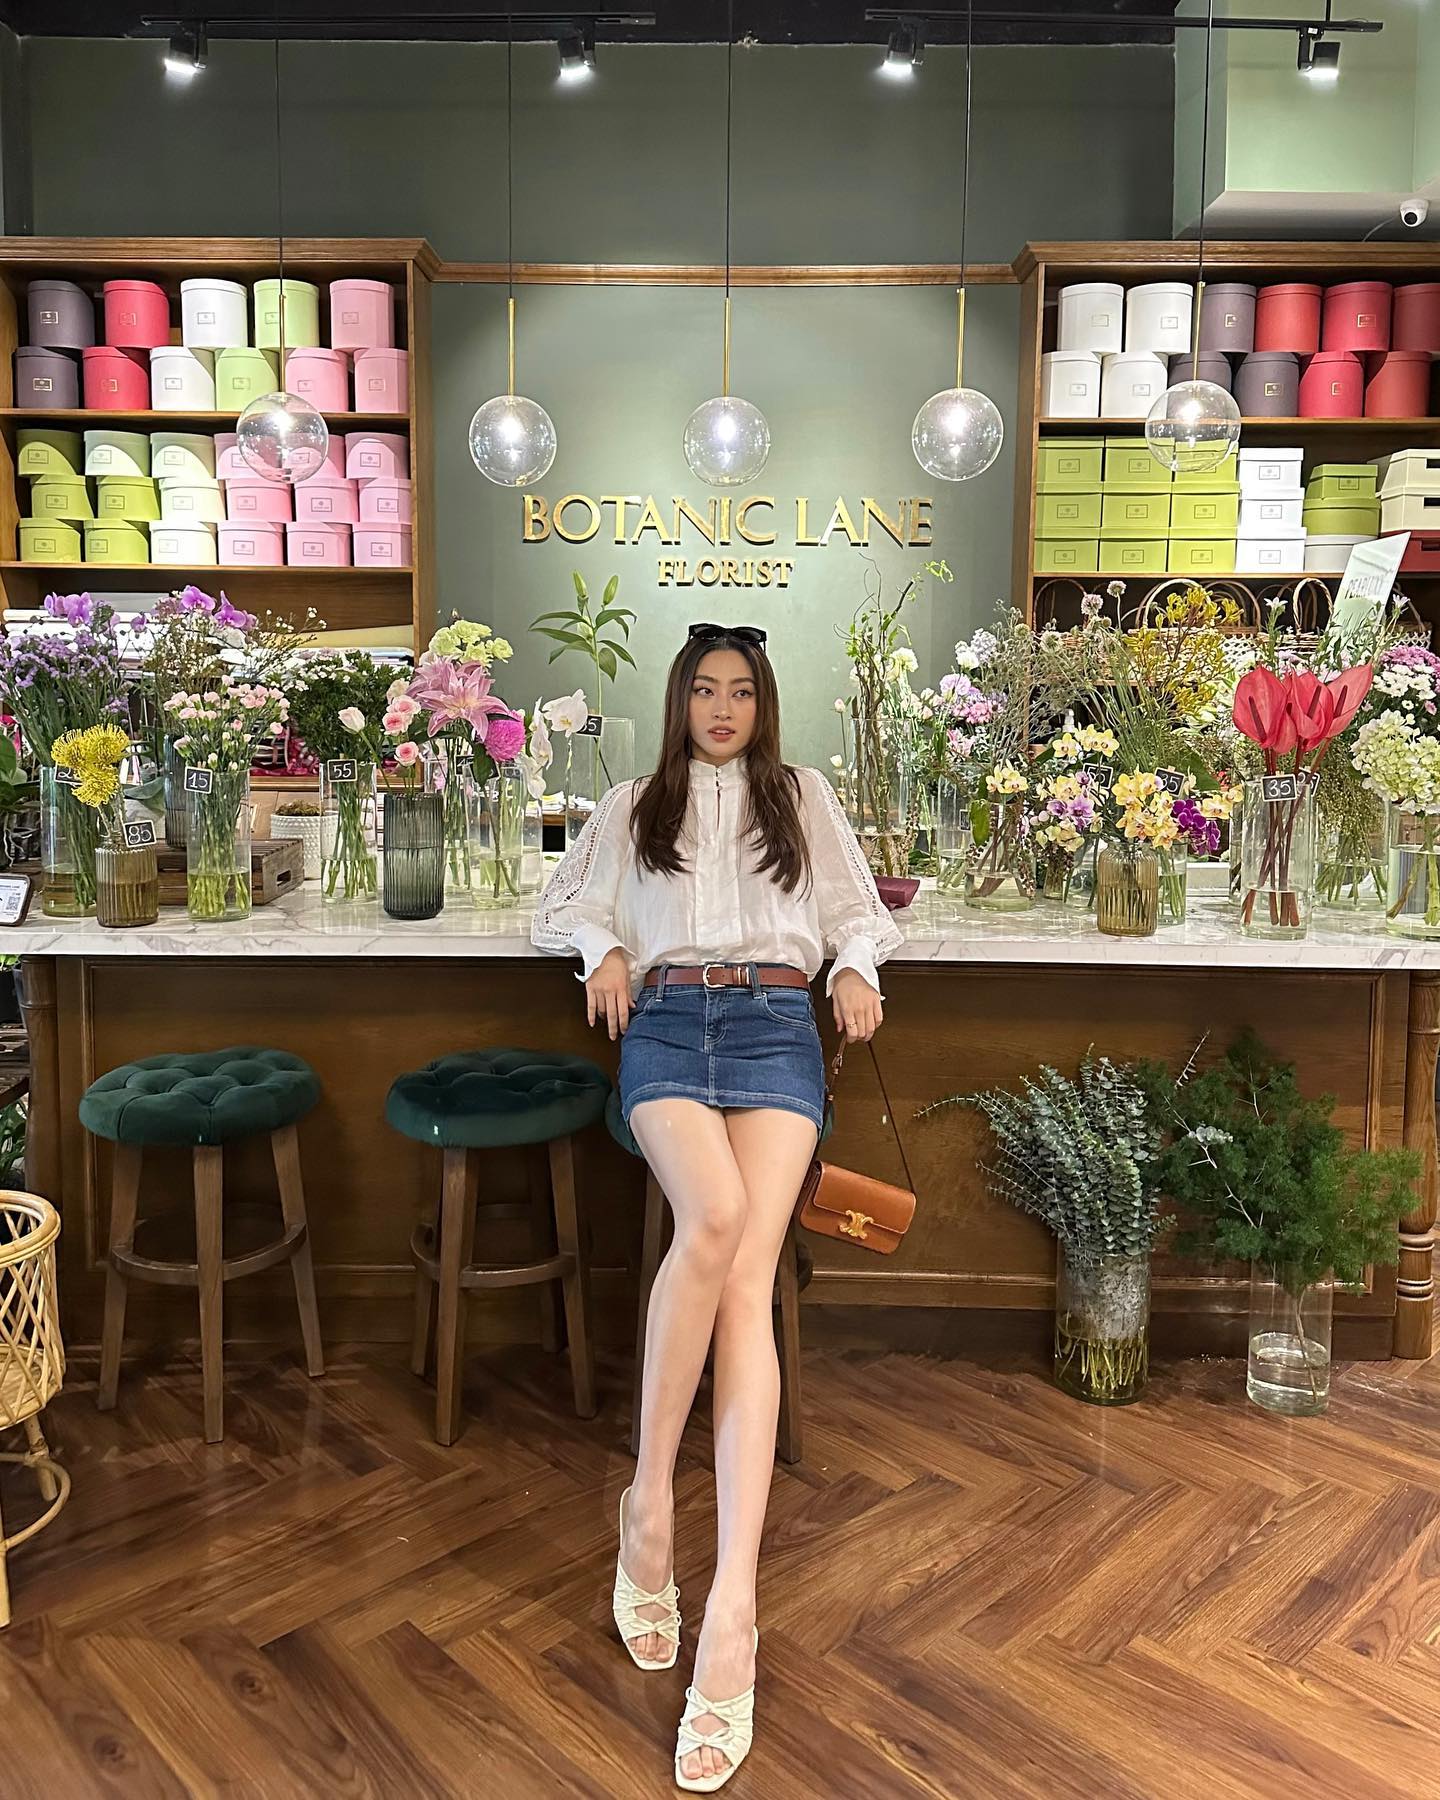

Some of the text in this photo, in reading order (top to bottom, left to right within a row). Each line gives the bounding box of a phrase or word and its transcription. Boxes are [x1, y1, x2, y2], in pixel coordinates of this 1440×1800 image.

[523, 494, 933, 549] BOTANIC LANE
[658, 558, 794, 588] FLORIST
[581, 717, 597, 732] 5
[333, 763, 352, 779] 55
[188, 772, 208, 789] 15
[1269, 779, 1291, 797] 35
[128, 825, 152, 844] 85
